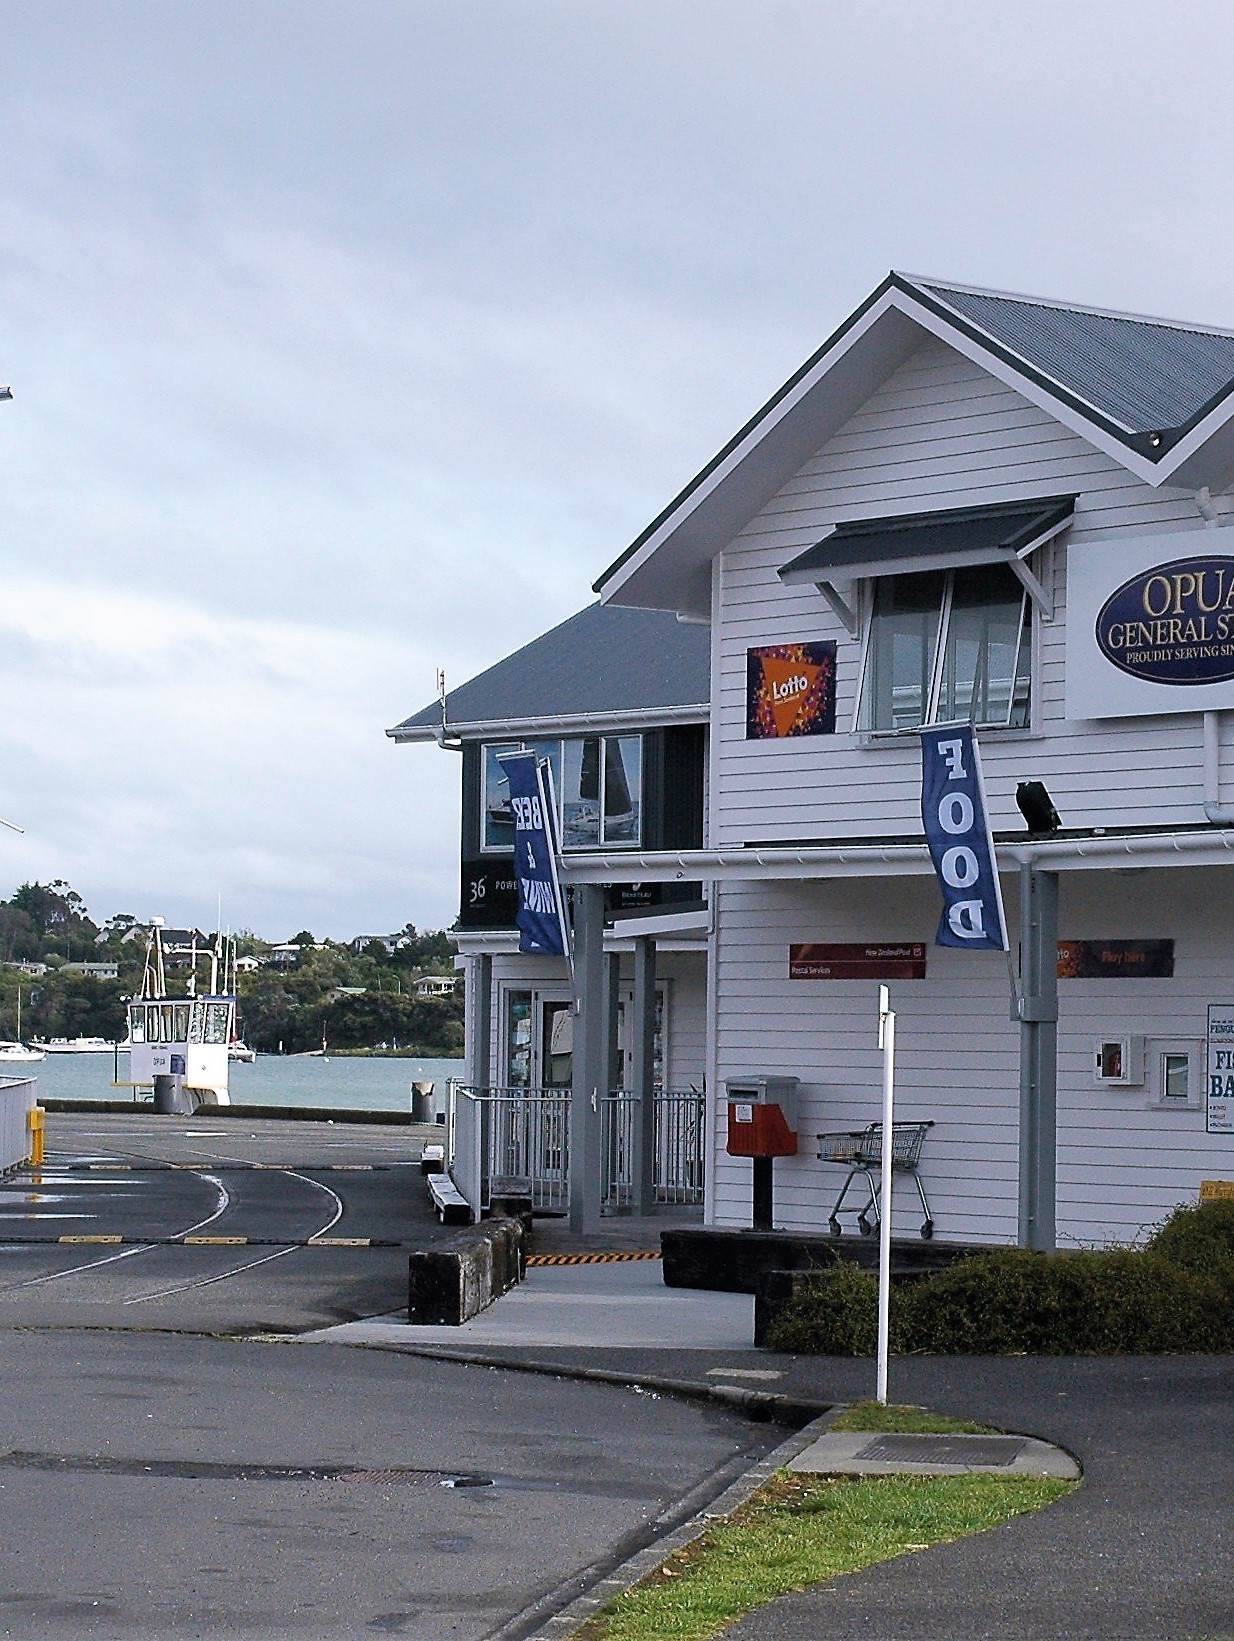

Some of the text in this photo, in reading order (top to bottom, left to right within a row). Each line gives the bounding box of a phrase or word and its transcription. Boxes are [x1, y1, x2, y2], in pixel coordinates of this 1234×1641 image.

[1108, 616, 1213, 649] GENERAL
[1126, 649, 1173, 664] PROUDLY
[1175, 645, 1220, 660] SERVING
[773, 675, 808, 700] Lotto
